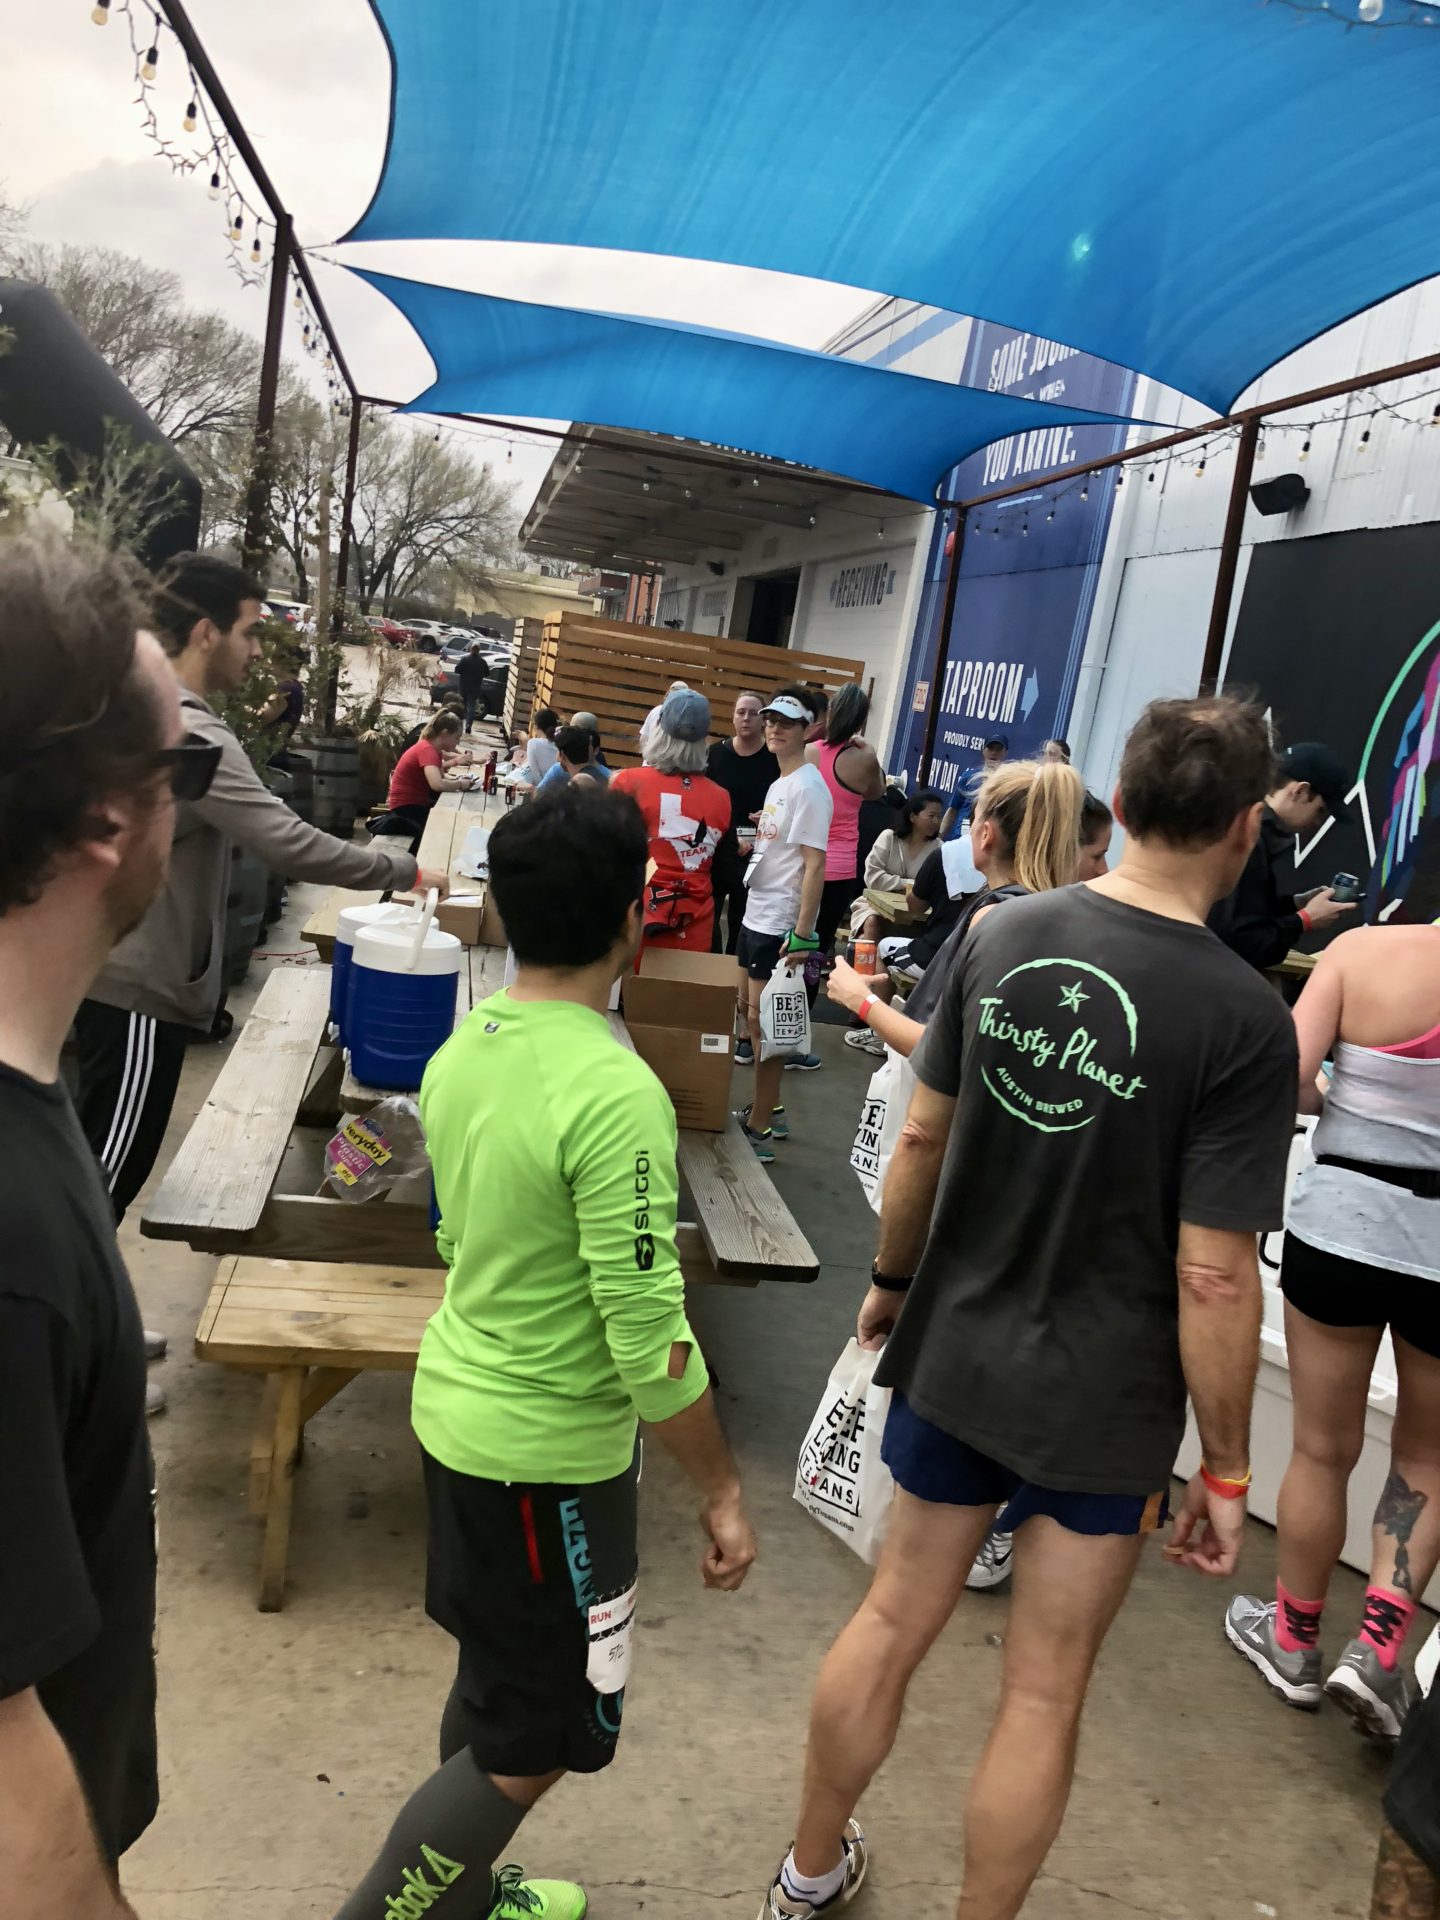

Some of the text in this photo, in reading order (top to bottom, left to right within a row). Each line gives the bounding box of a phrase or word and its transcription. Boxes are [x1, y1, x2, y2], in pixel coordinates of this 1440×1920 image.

[982, 436, 1015, 486] YOU
[835, 562, 888, 608] RECEIVING
[939, 660, 1024, 724] TAPROOM
[943, 730, 970, 748] PROUDLY
[939, 761, 960, 794] DAY
[680, 846, 707, 858] TEAM
[978, 997, 1148, 1100] Thirsty Planet
[996, 1066, 1084, 1115] AUSTIN BREWED
[337, 1136, 365, 1170] Plastic
[346, 1123, 386, 1159] veryday
[336, 1150, 353, 1168] Cups
[590, 1610, 612, 1625] RUN
